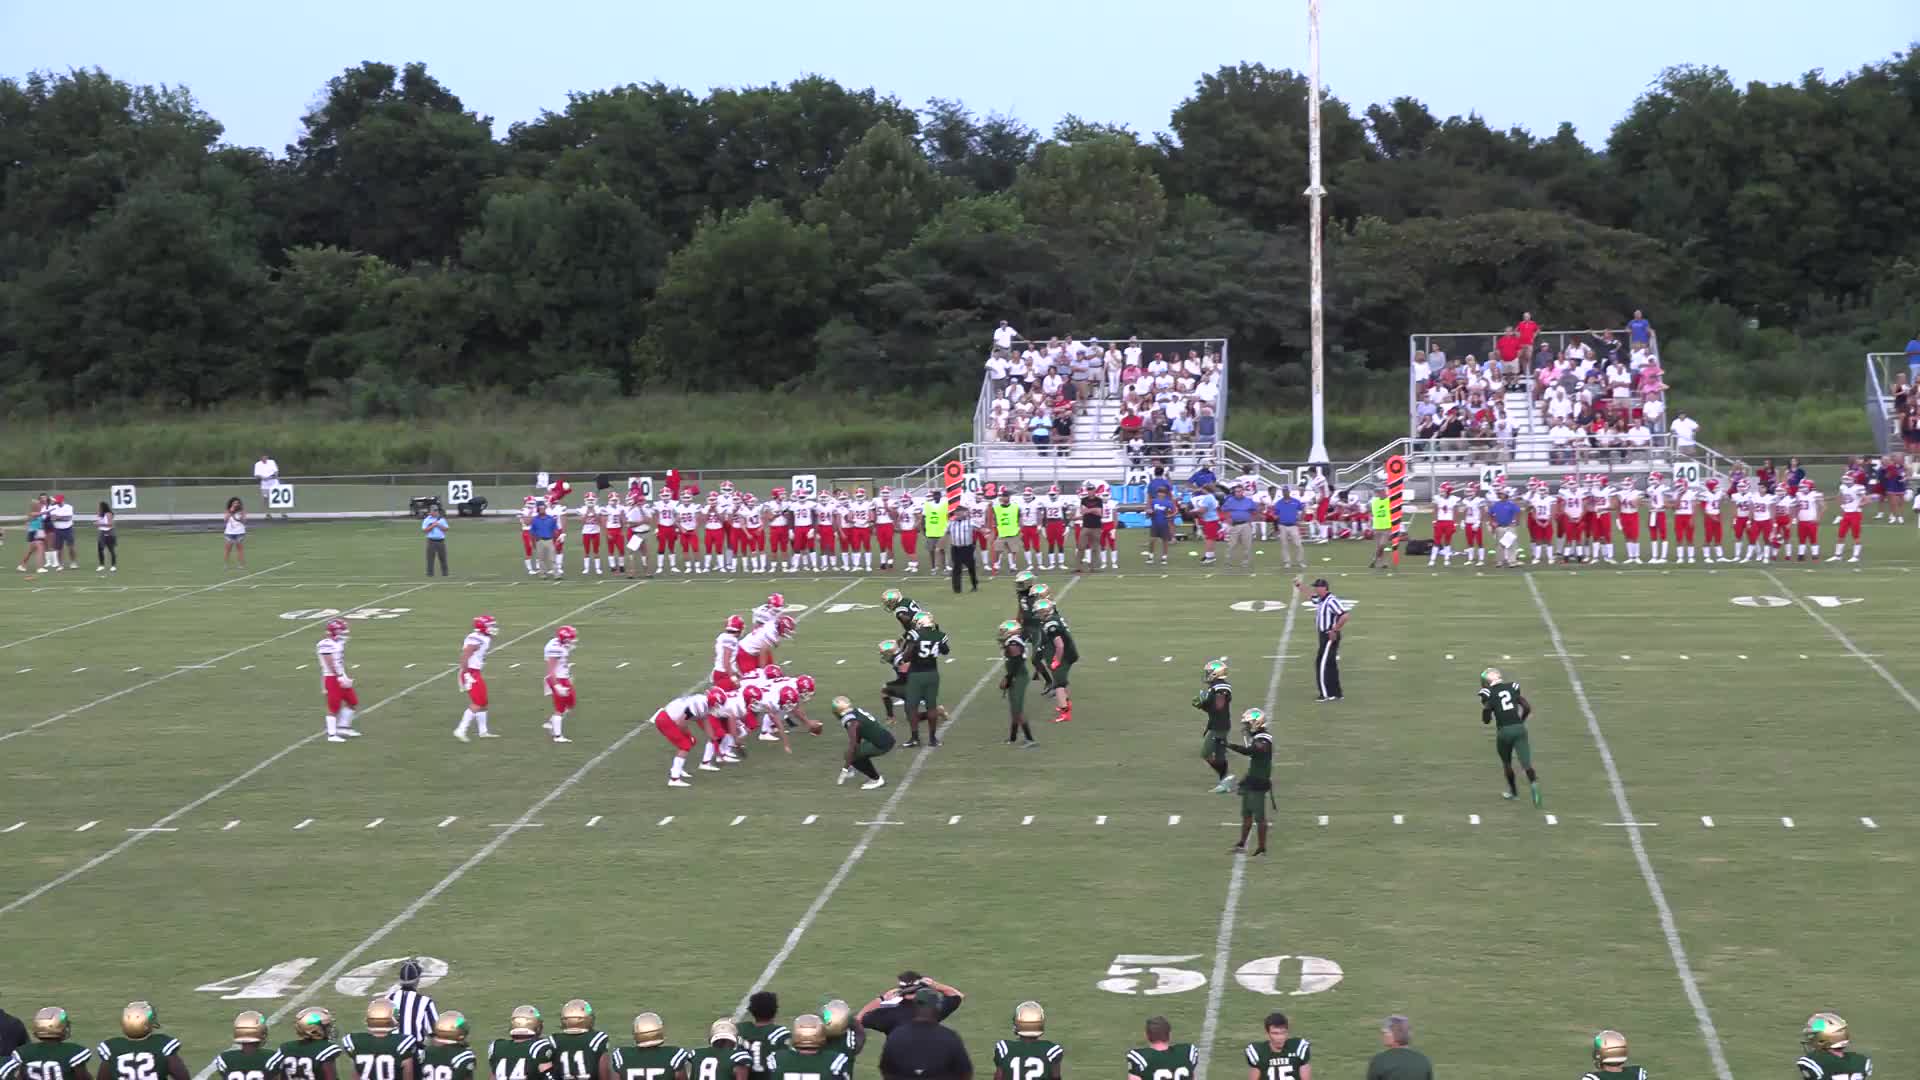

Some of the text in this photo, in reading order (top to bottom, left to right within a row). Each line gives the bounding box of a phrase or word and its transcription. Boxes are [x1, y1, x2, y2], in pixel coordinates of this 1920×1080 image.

[1676, 466, 1696, 482] 40
[114, 488, 132, 505] 15
[271, 488, 291, 504] 20
[452, 484, 469, 500] 25
[1498, 690, 1514, 710] 2
[194, 957, 448, 999] 40
[1096, 954, 1344, 995] 50
[27, 1061, 63, 1080] 50
[117, 1052, 158, 1080] 52
[355, 1054, 395, 1080] 70
[495, 1058, 527, 1080] 44
[559, 1050, 591, 1079] 11
[1010, 1056, 1044, 1080] 12
[1267, 1065, 1296, 1080] 15
